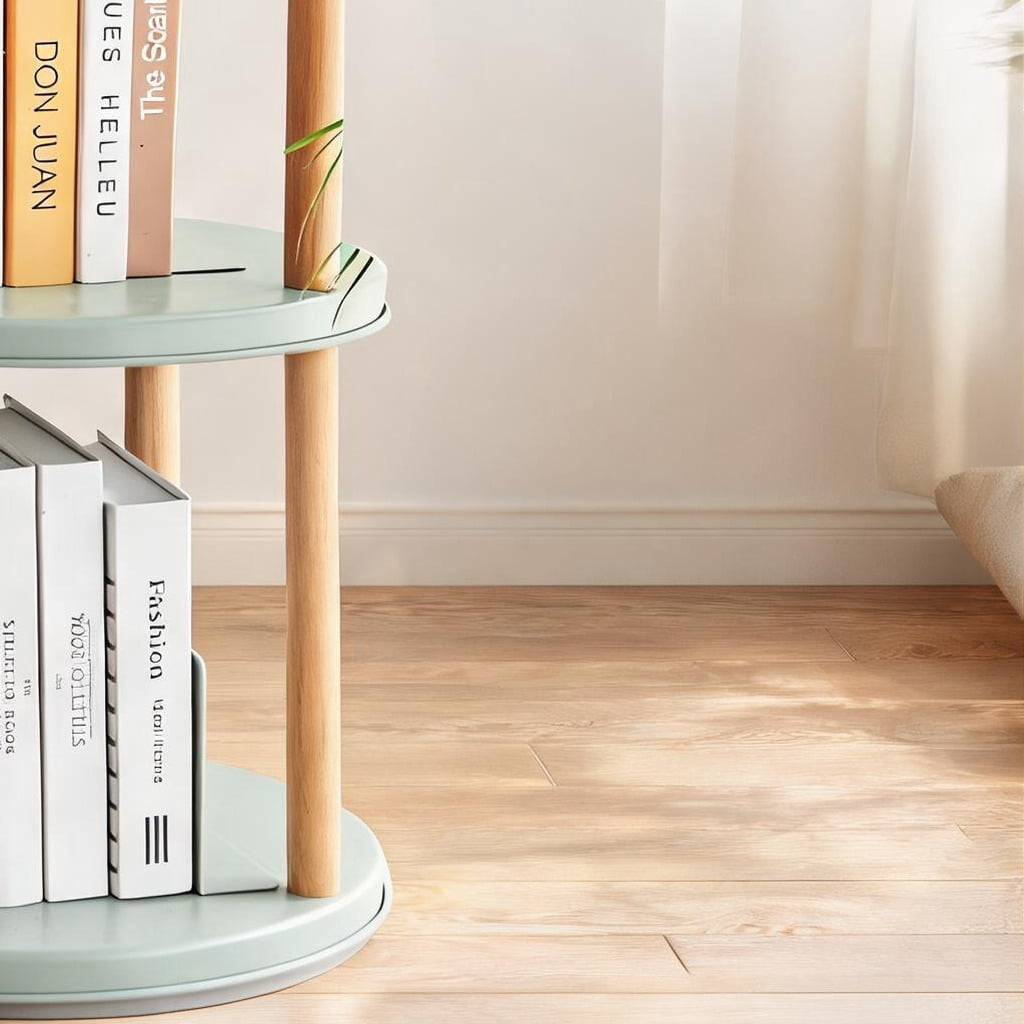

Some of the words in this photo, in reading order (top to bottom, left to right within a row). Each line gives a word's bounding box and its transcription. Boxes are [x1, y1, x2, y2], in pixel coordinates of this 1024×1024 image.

[33, 41, 59, 113] DON
[140, 70, 166, 120] The
[31, 125, 58, 210] JUAN
[96, 95, 120, 217] HELLEU
